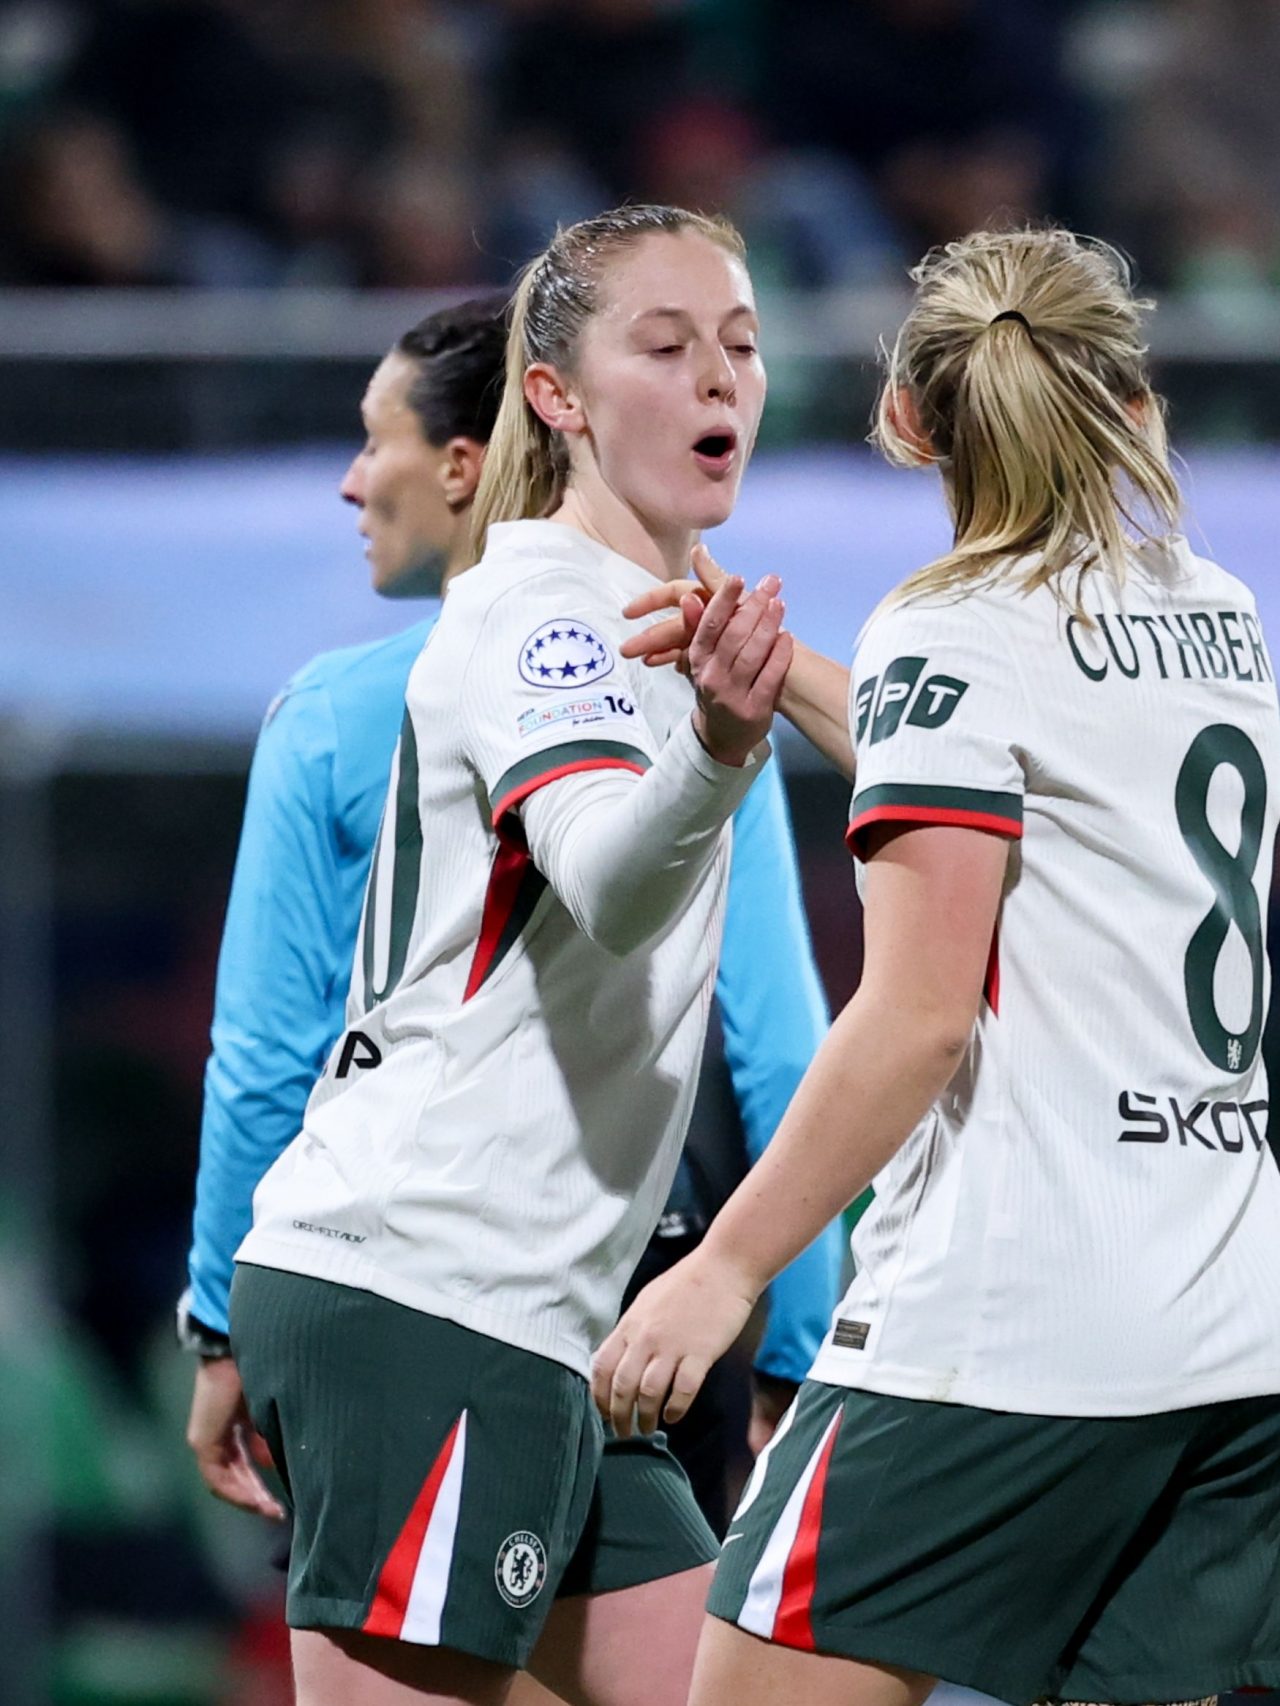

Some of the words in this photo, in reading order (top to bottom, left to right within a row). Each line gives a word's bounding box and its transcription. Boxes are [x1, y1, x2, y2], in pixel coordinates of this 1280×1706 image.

[1066, 611, 1272, 682] CUTHBER
[1175, 722, 1268, 1075] 8
[508, 1534, 541, 1556] CHELSEA
